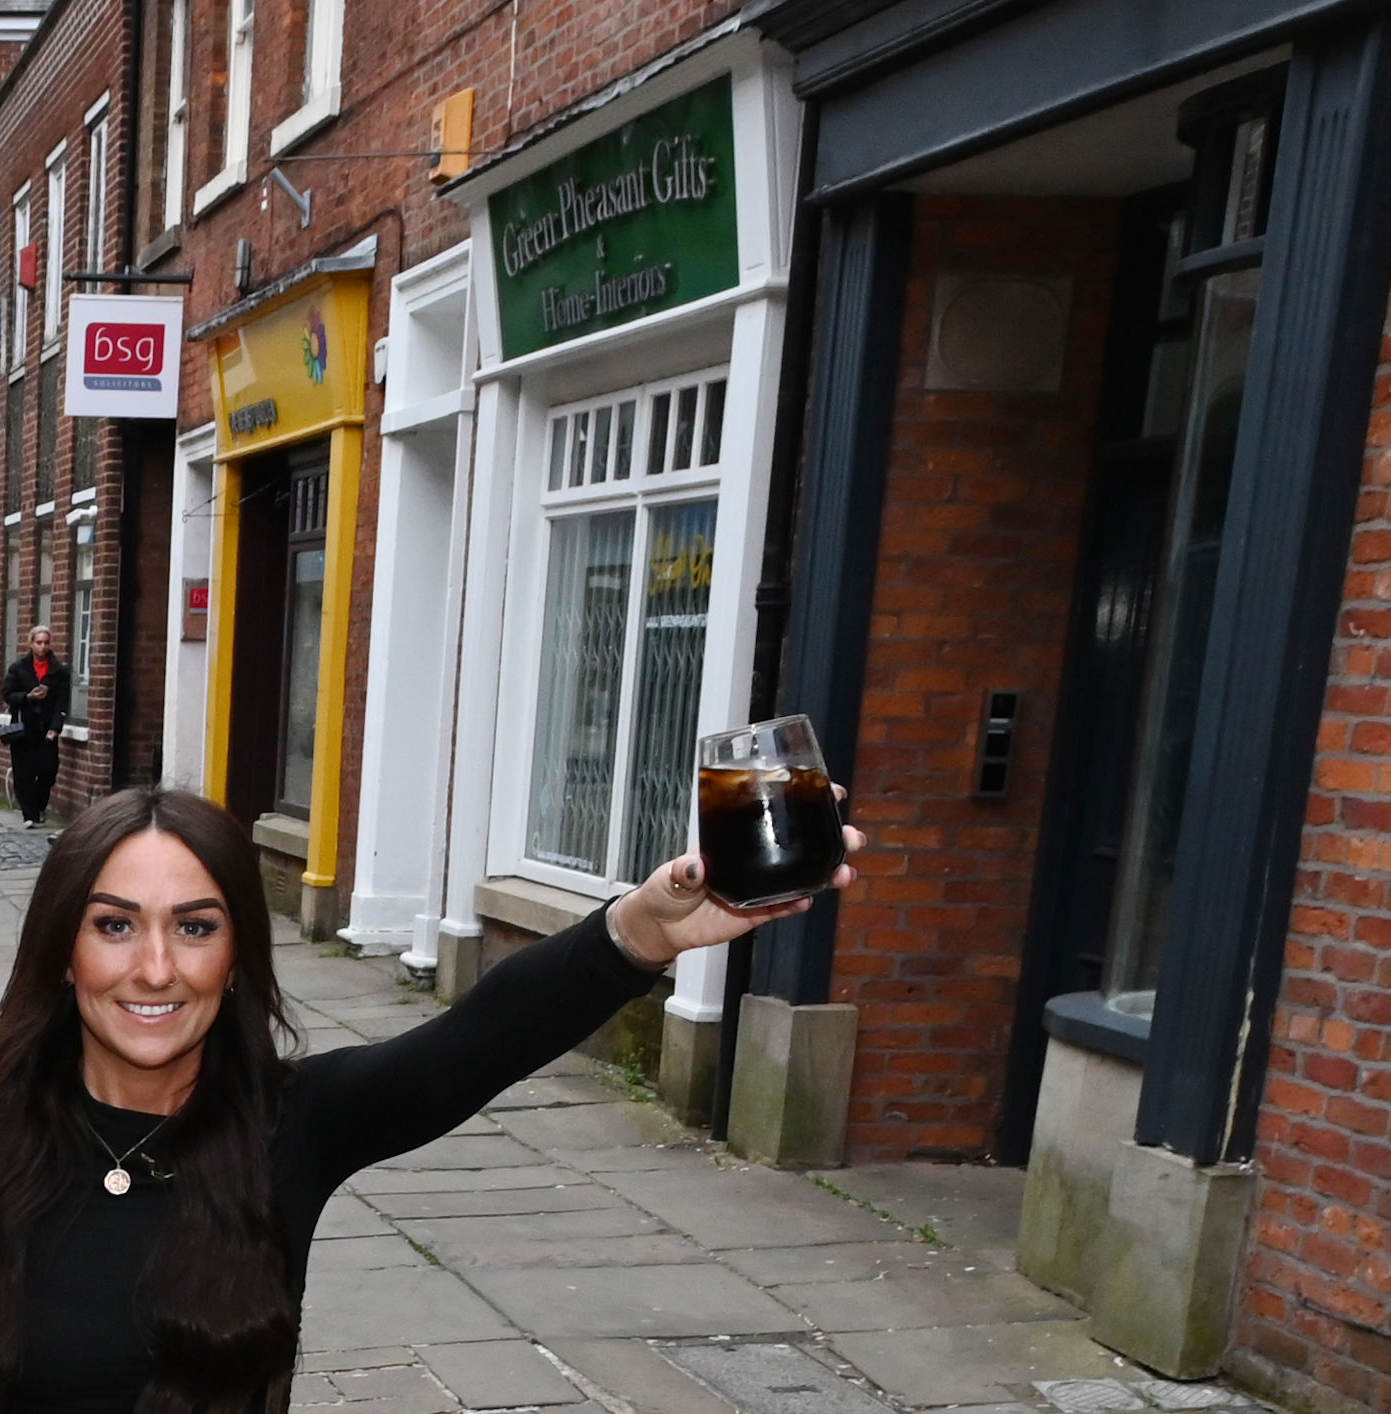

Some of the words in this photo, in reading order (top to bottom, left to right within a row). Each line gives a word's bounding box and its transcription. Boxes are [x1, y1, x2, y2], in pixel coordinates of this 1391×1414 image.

[502, 212, 556, 277] Green
[558, 162, 648, 239] Pheasant
[652, 135, 707, 203] Gifts
[542, 287, 590, 332] Home
[595, 263, 666, 316] Interiors
[94, 327, 155, 372] bsg
[93, 380, 153, 388] SOLICITORS
